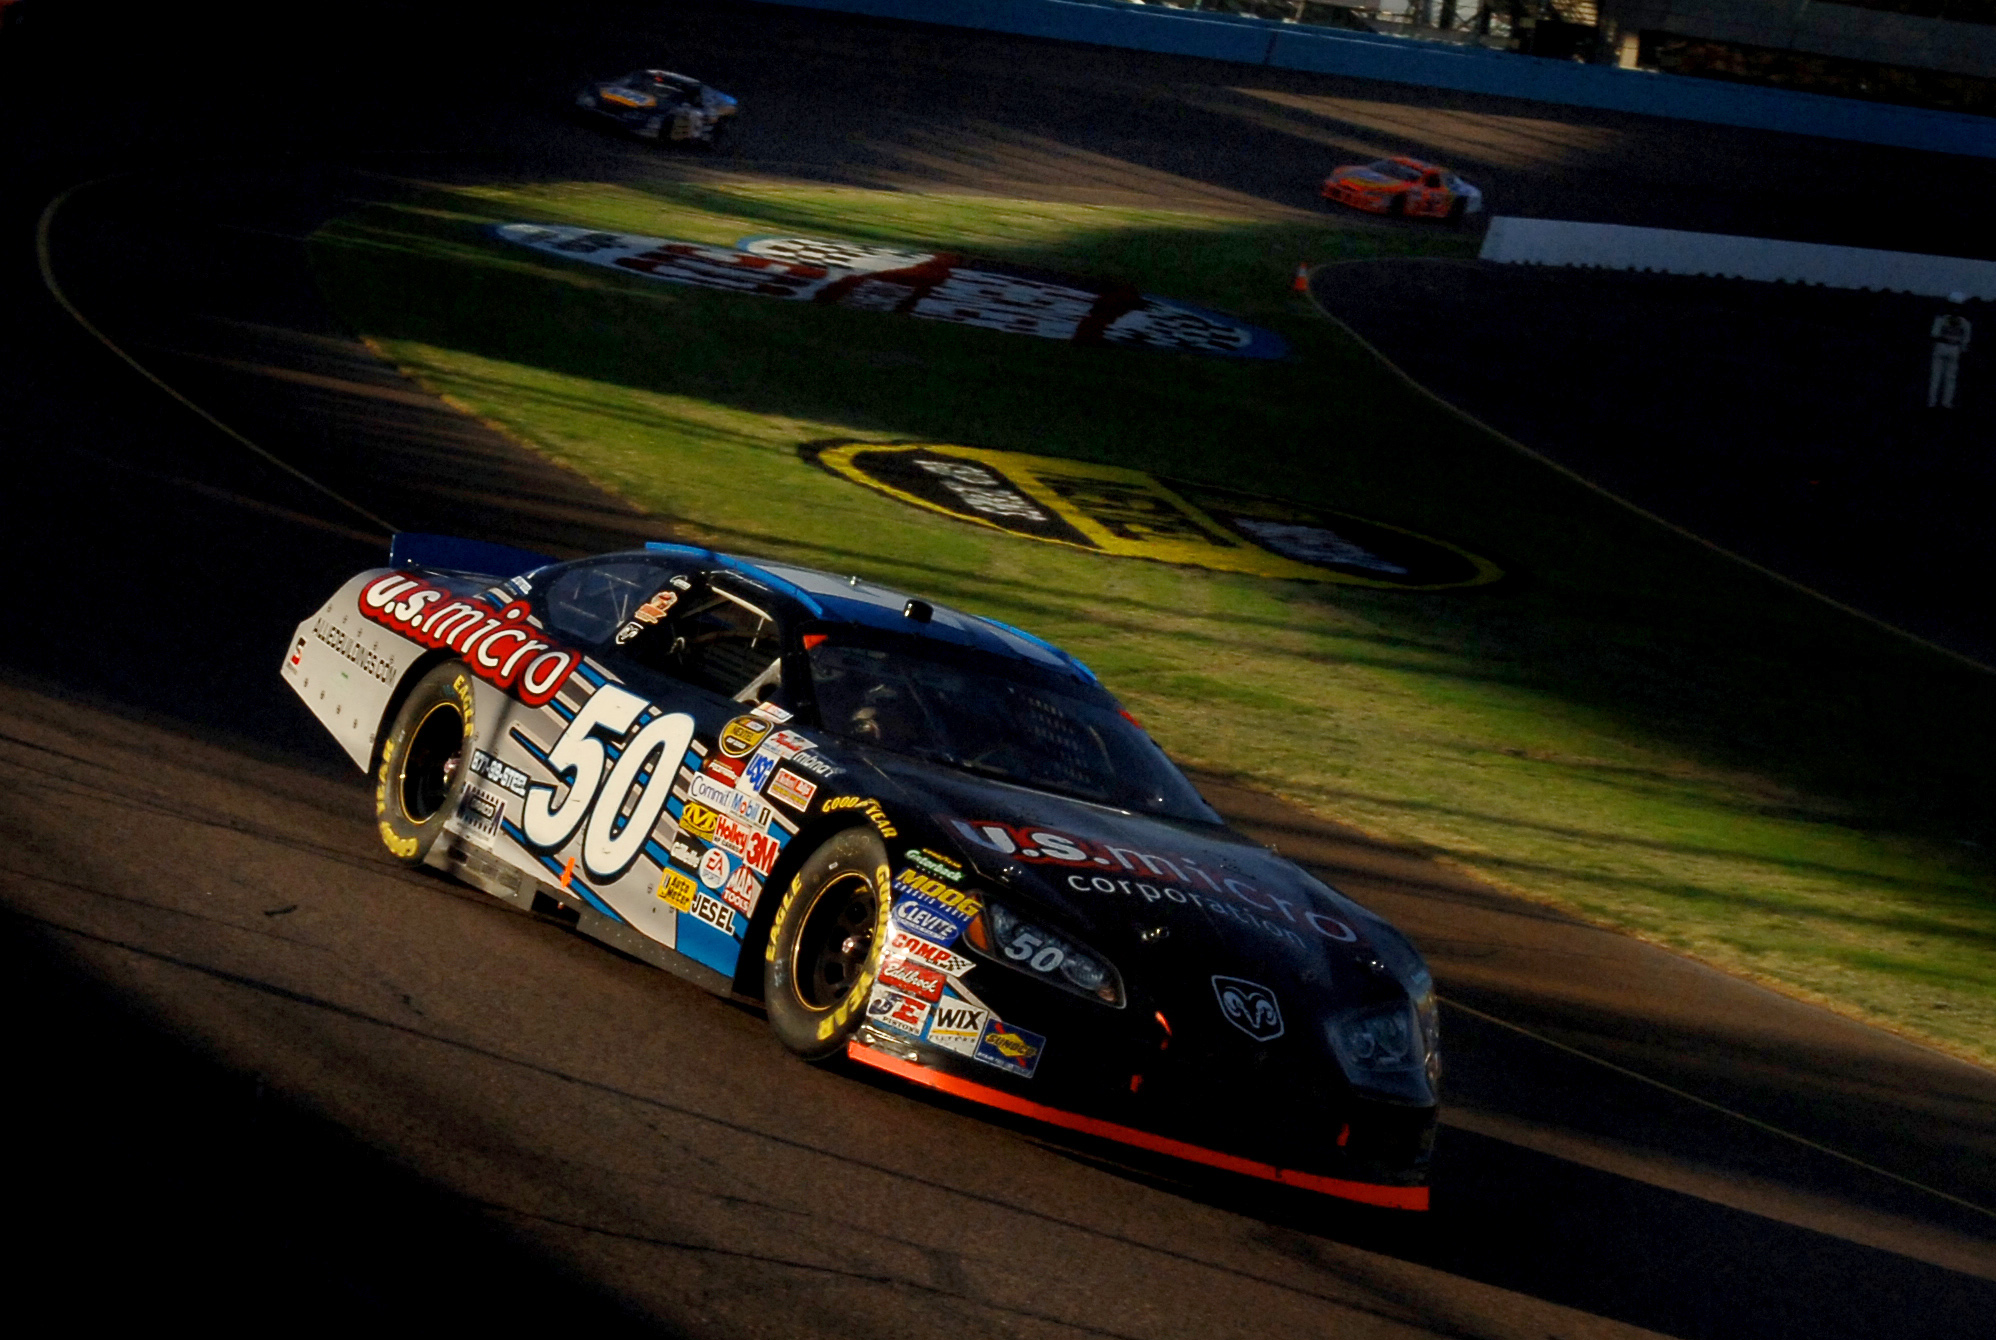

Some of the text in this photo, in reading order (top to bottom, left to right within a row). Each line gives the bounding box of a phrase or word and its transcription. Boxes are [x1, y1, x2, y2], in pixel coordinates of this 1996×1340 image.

[525, 684, 695, 884] 50
[729, 791, 761, 822] Mobil
[758, 806, 772, 826] 1
[715, 816, 749, 855] Holley
[746, 831, 779, 877] 3M
[705, 851, 724, 877] EA
[722, 891, 751, 913] TOOLS
[895, 867, 984, 918] MOOG
[1067, 871, 1309, 949] corporation
[691, 893, 735, 933] JESEL
[896, 900, 958, 938] CLEVITE
[891, 933, 952, 962] COMP
[1004, 932, 1065, 972] 50
[881, 1015, 920, 1035] PISTONS
[936, 1006, 986, 1031] WIX
[986, 1033, 1039, 1057] SUNOCO
